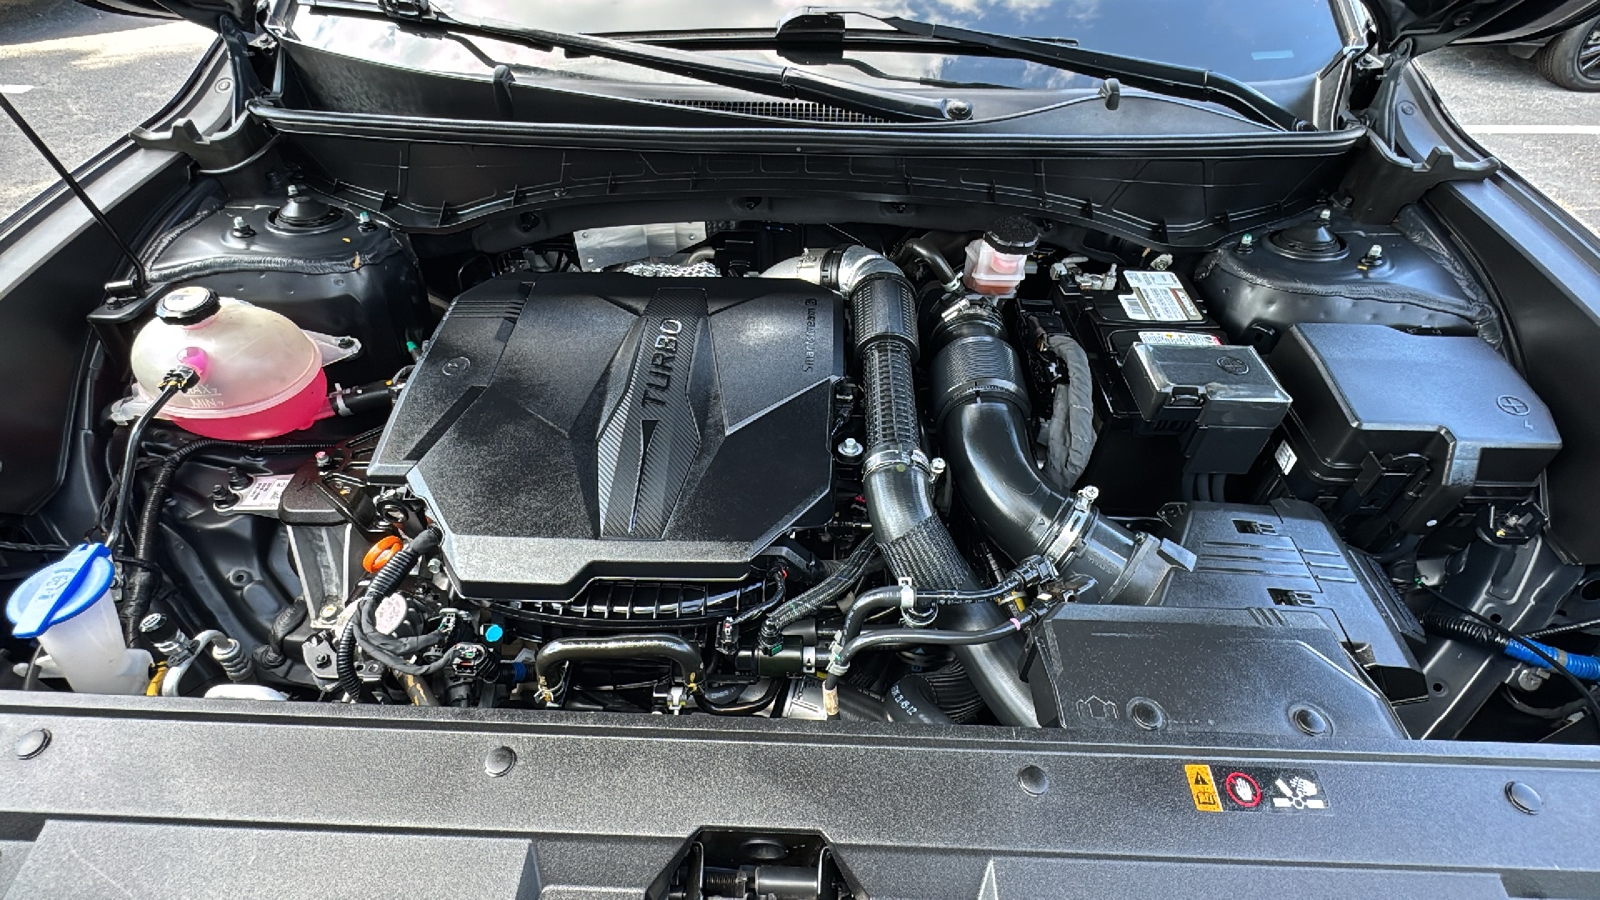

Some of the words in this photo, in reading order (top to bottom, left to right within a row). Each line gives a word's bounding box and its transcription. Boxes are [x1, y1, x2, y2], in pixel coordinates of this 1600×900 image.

[641, 318, 683, 408] TURBO
[803, 308, 815, 373] Smartstream
[190, 398, 217, 407] MIN
